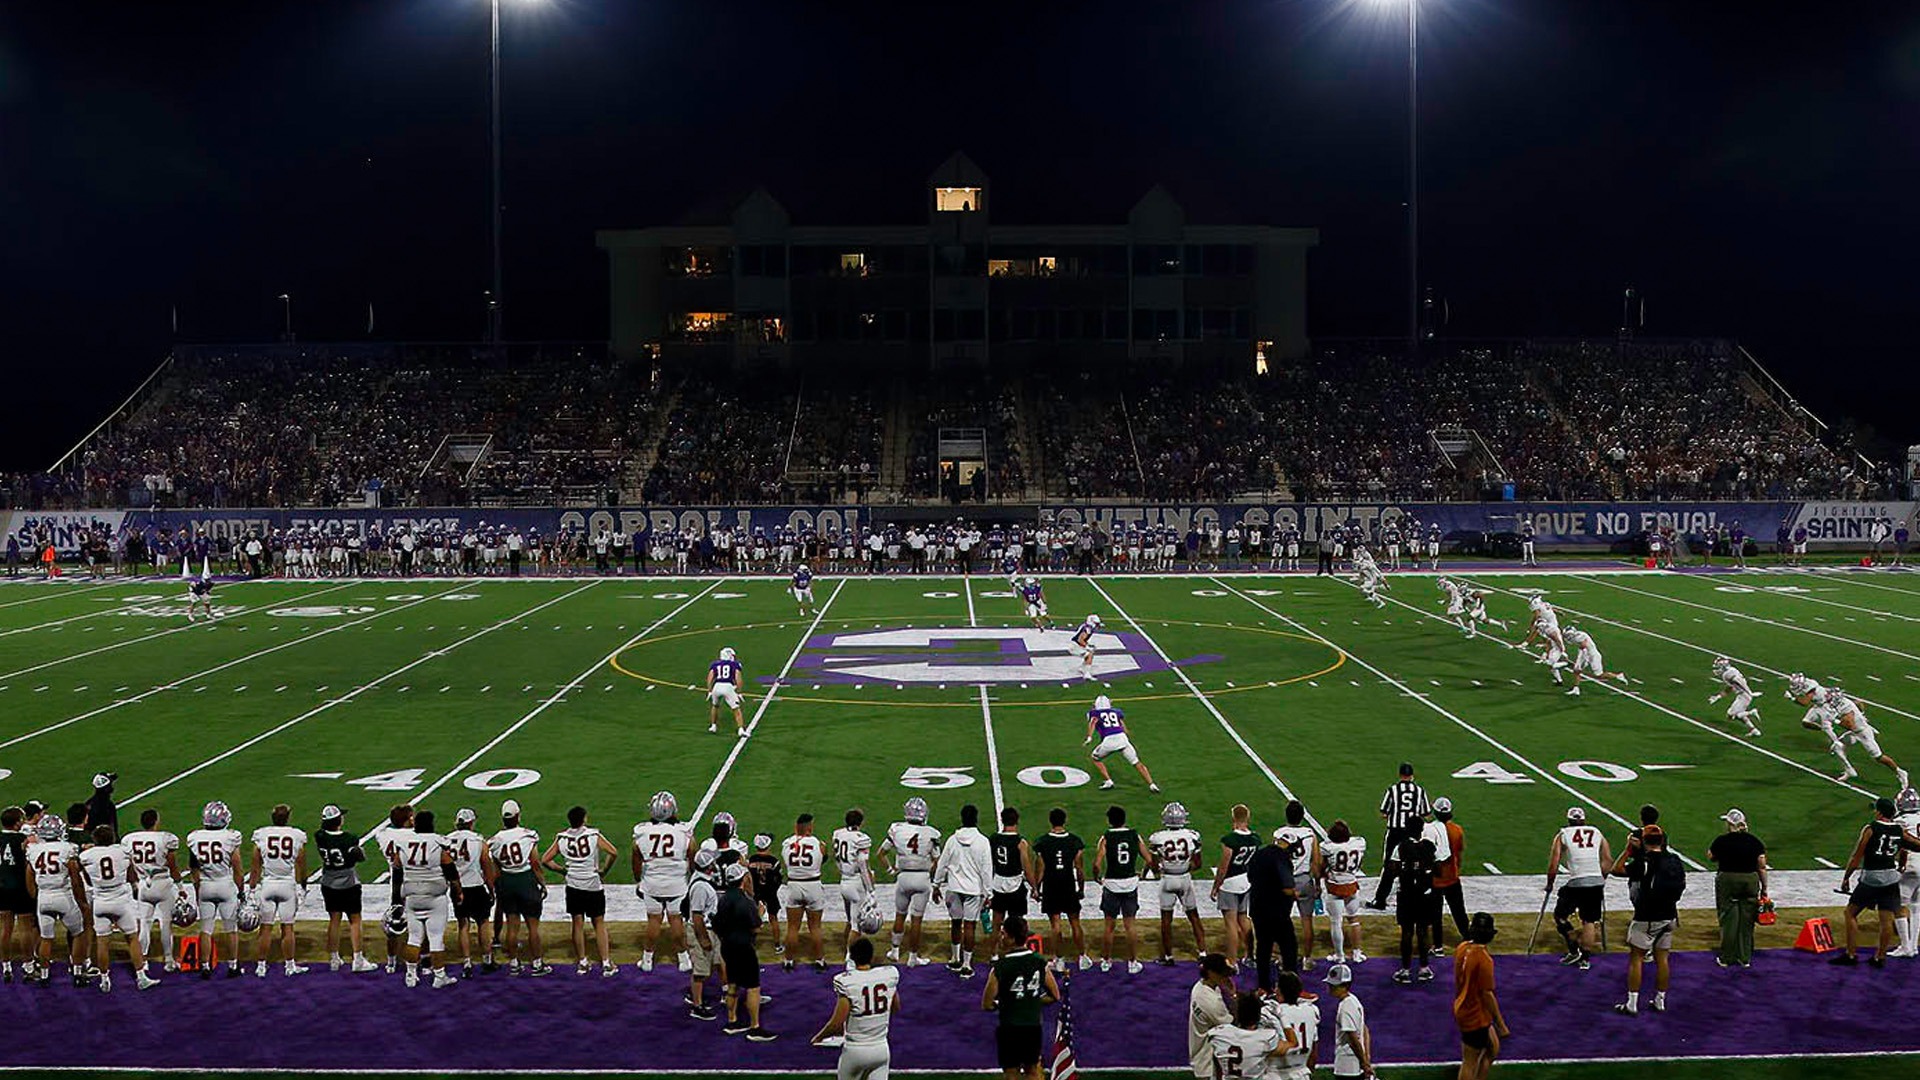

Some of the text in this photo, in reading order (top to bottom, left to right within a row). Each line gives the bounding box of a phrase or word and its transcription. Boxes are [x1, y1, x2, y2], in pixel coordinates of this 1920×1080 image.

[1813, 506, 1887, 517] FIGHTING
[1597, 512, 1630, 535] NO
[716, 665, 731, 679] 18
[1101, 712, 1119, 728] 39
[267, 836, 294, 860] 59
[649, 834, 675, 857] 72
[907, 833, 919, 855] 4
[1572, 829, 1595, 848] 47
[1874, 833, 1902, 858] 15
[35, 850, 59, 875] 45
[131, 841, 156, 864] 52
[198, 841, 223, 864] 56
[407, 842, 429, 866] 71
[789, 842, 813, 867] 25
[1117, 842, 1130, 864] 6
[100, 856, 115, 880] 8
[1009, 970, 1041, 999] 44
[861, 983, 888, 1015] 16
